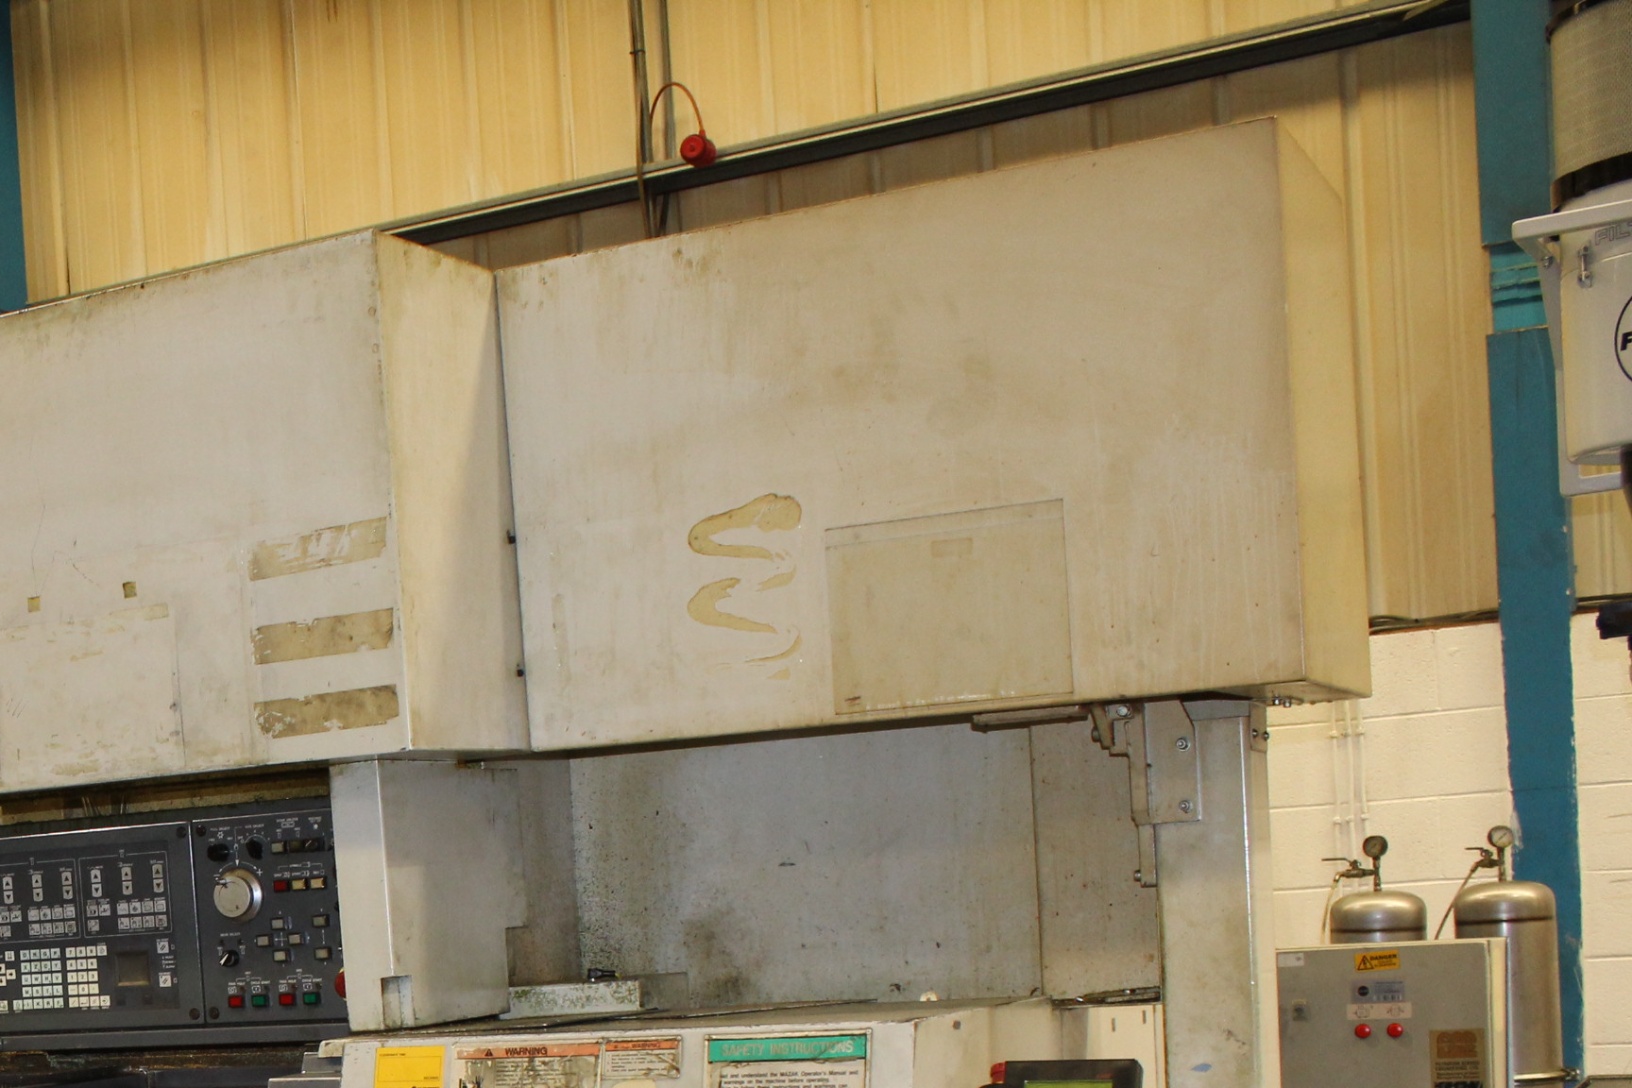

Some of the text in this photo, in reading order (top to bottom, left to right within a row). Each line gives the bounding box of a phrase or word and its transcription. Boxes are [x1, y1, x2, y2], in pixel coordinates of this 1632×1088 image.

[504, 1046, 548, 1056] WARNING
[722, 1040, 854, 1056] SAFETY INSTRUCTIONS
